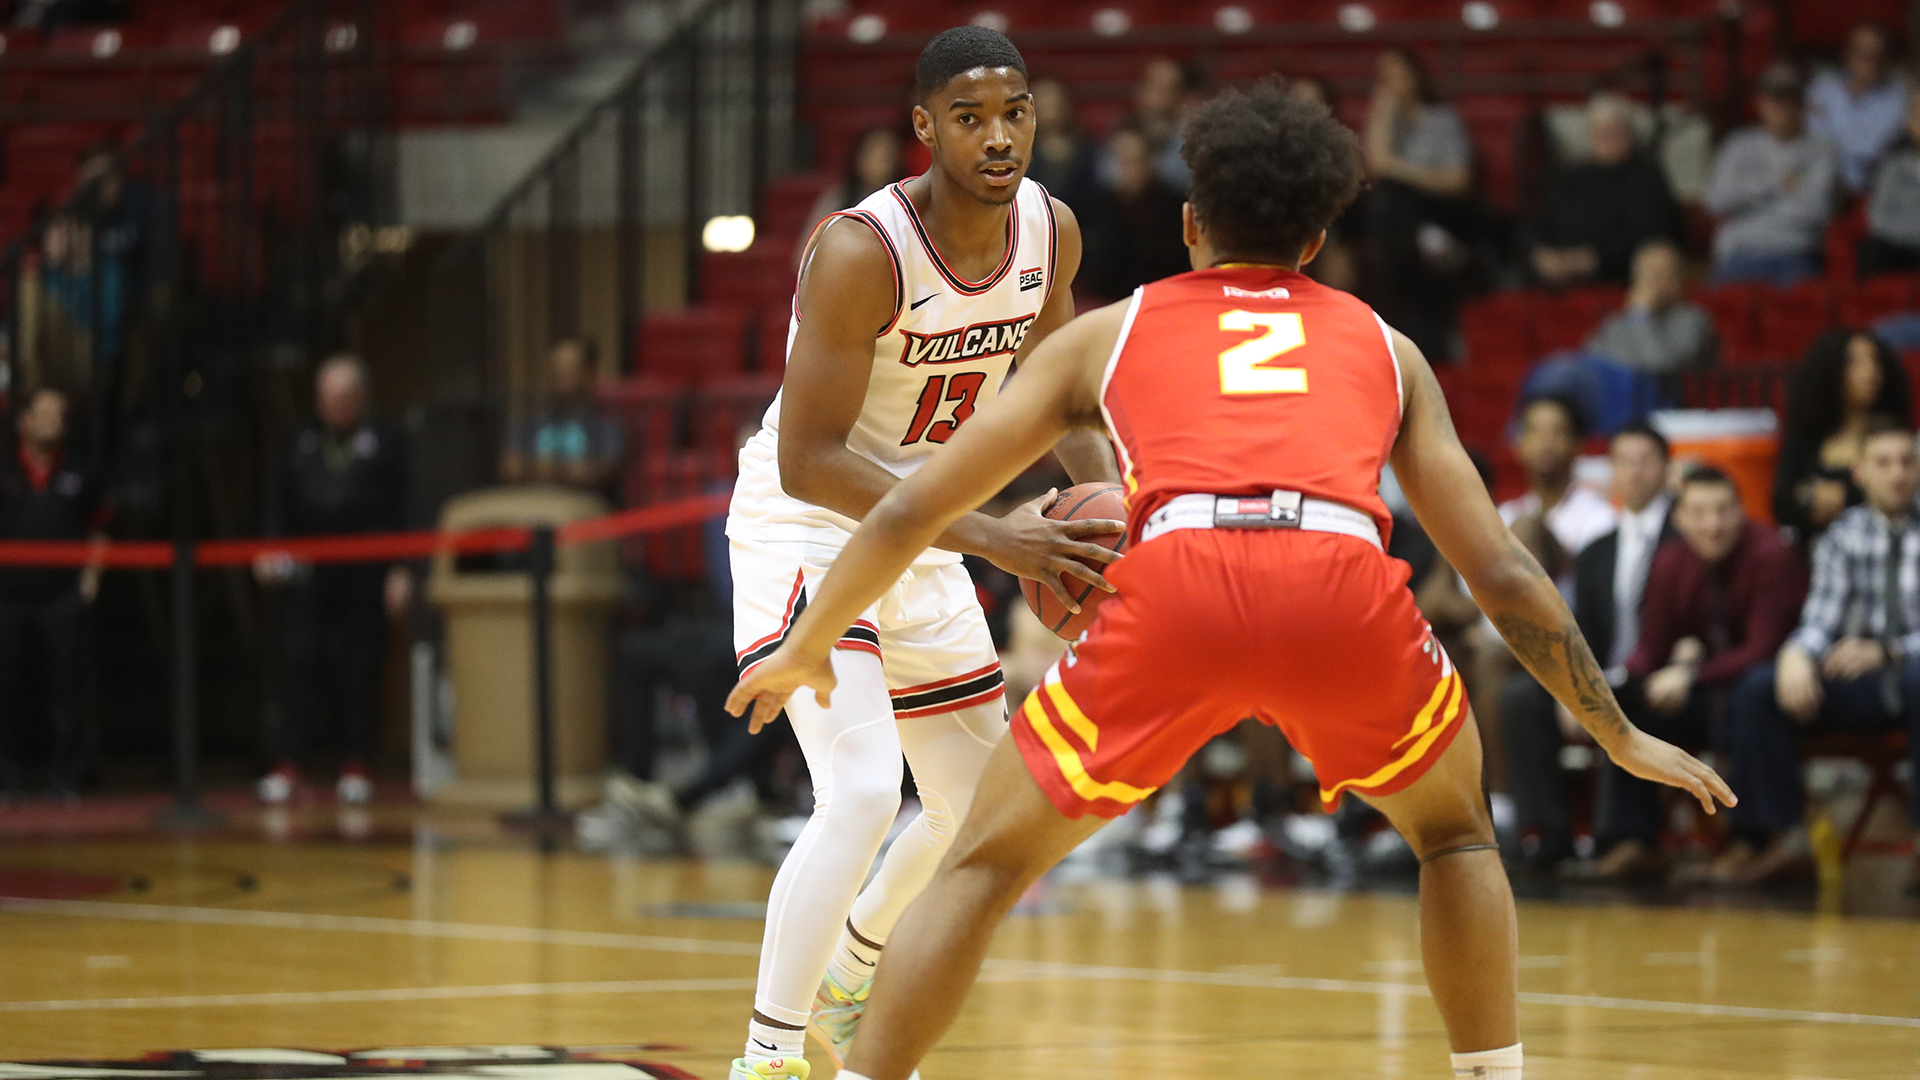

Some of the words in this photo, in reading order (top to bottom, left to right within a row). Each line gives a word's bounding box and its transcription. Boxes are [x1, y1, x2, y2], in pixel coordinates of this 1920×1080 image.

[1019, 271, 1043, 286] PSAC
[905, 318, 1034, 365] VULCANS
[1218, 308, 1308, 395] 2
[900, 372, 987, 446] 13
